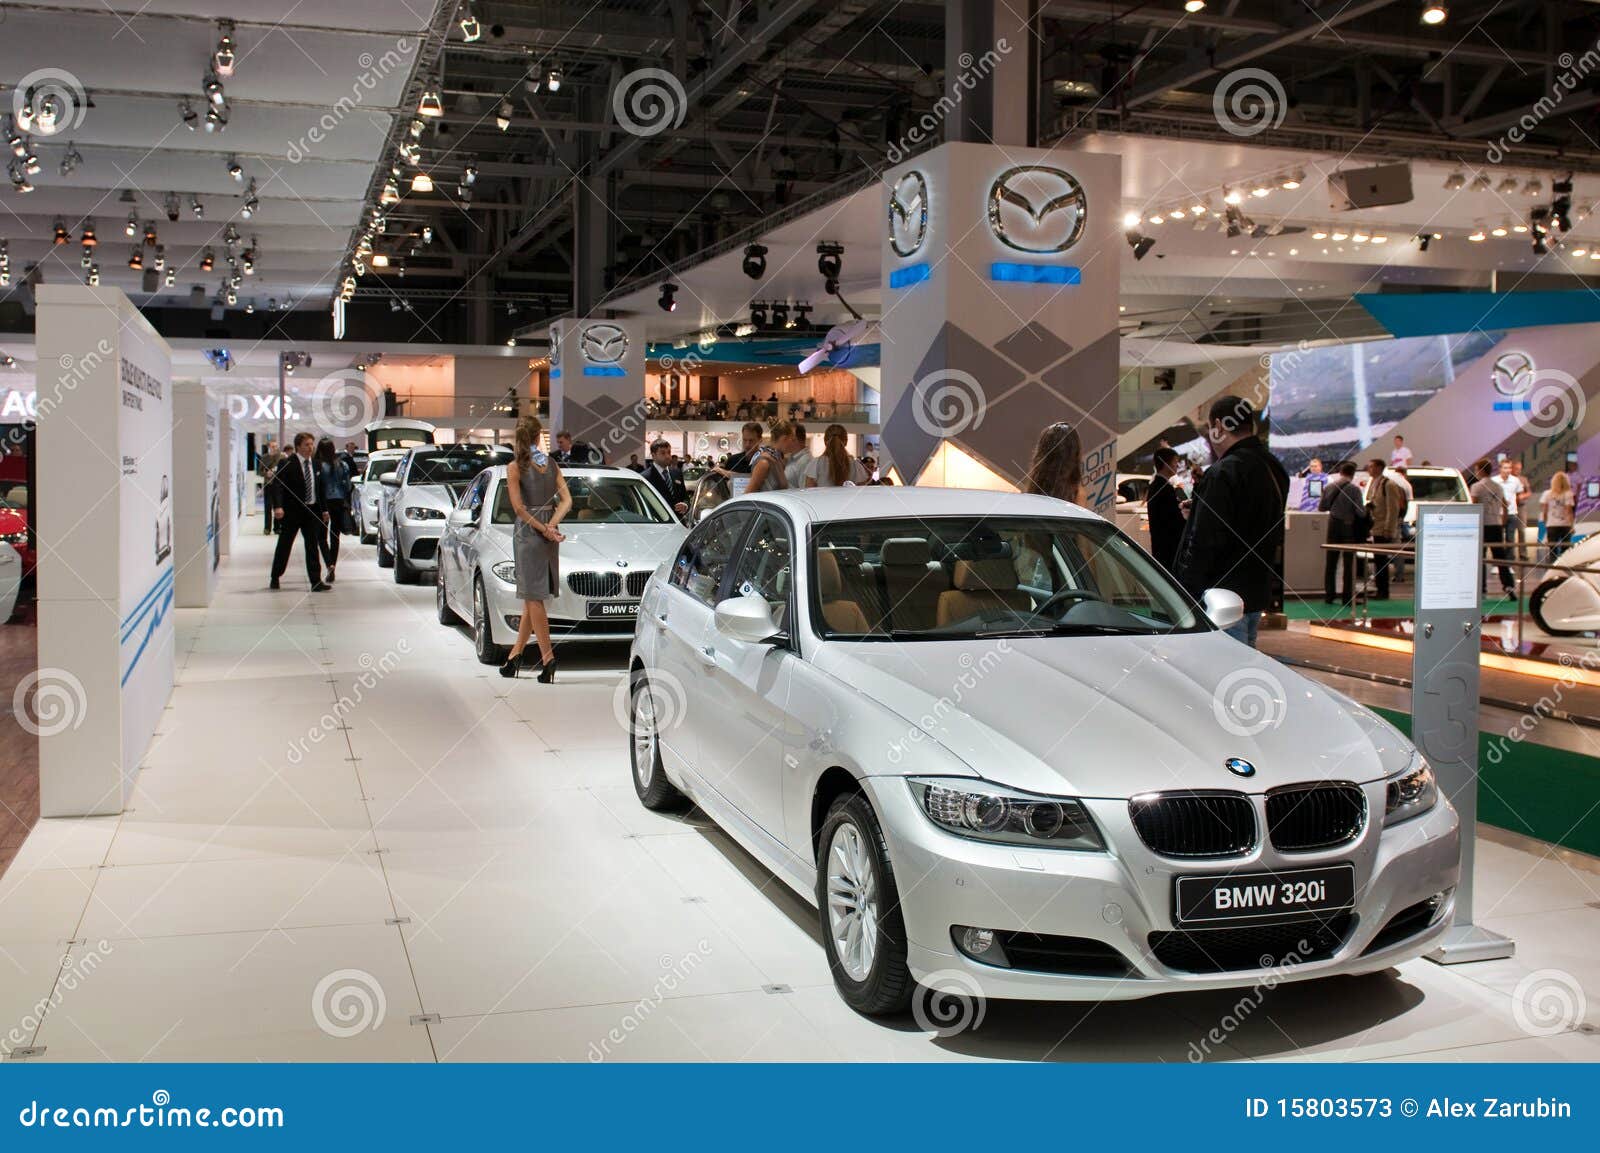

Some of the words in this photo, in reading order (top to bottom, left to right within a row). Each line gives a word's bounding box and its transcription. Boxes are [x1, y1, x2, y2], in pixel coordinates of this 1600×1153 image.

[602, 605, 627, 614] BMW
[1215, 884, 1276, 910] BMW
[1281, 880, 1326, 904] 320i
